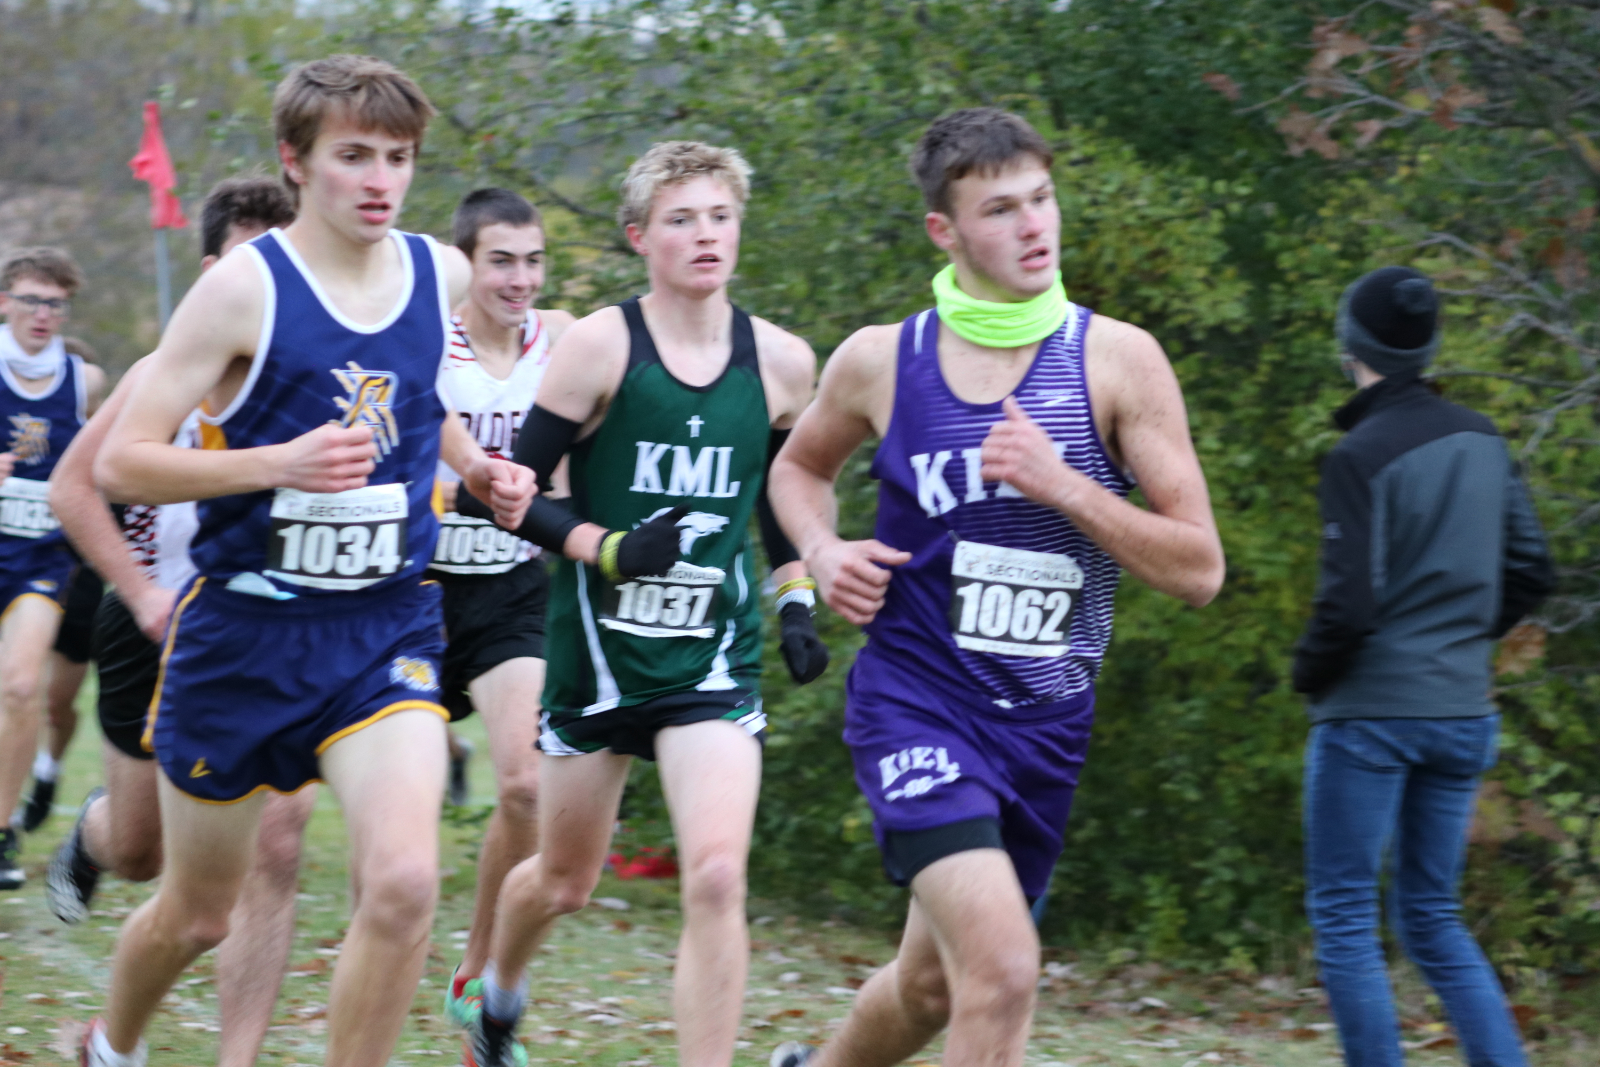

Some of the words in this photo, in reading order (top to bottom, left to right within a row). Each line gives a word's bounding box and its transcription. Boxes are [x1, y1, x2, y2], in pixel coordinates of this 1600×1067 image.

[629, 441, 741, 498] KML
[910, 443, 1067, 518] KI
[307, 501, 401, 517] SECTIONALS
[278, 522, 400, 576] 1034
[434, 526, 519, 563] 1099
[986, 563, 1079, 583] SECTIONALS
[614, 582, 714, 627] 1037
[956, 582, 1072, 642] 1062
[878, 746, 961, 790] KIEL
